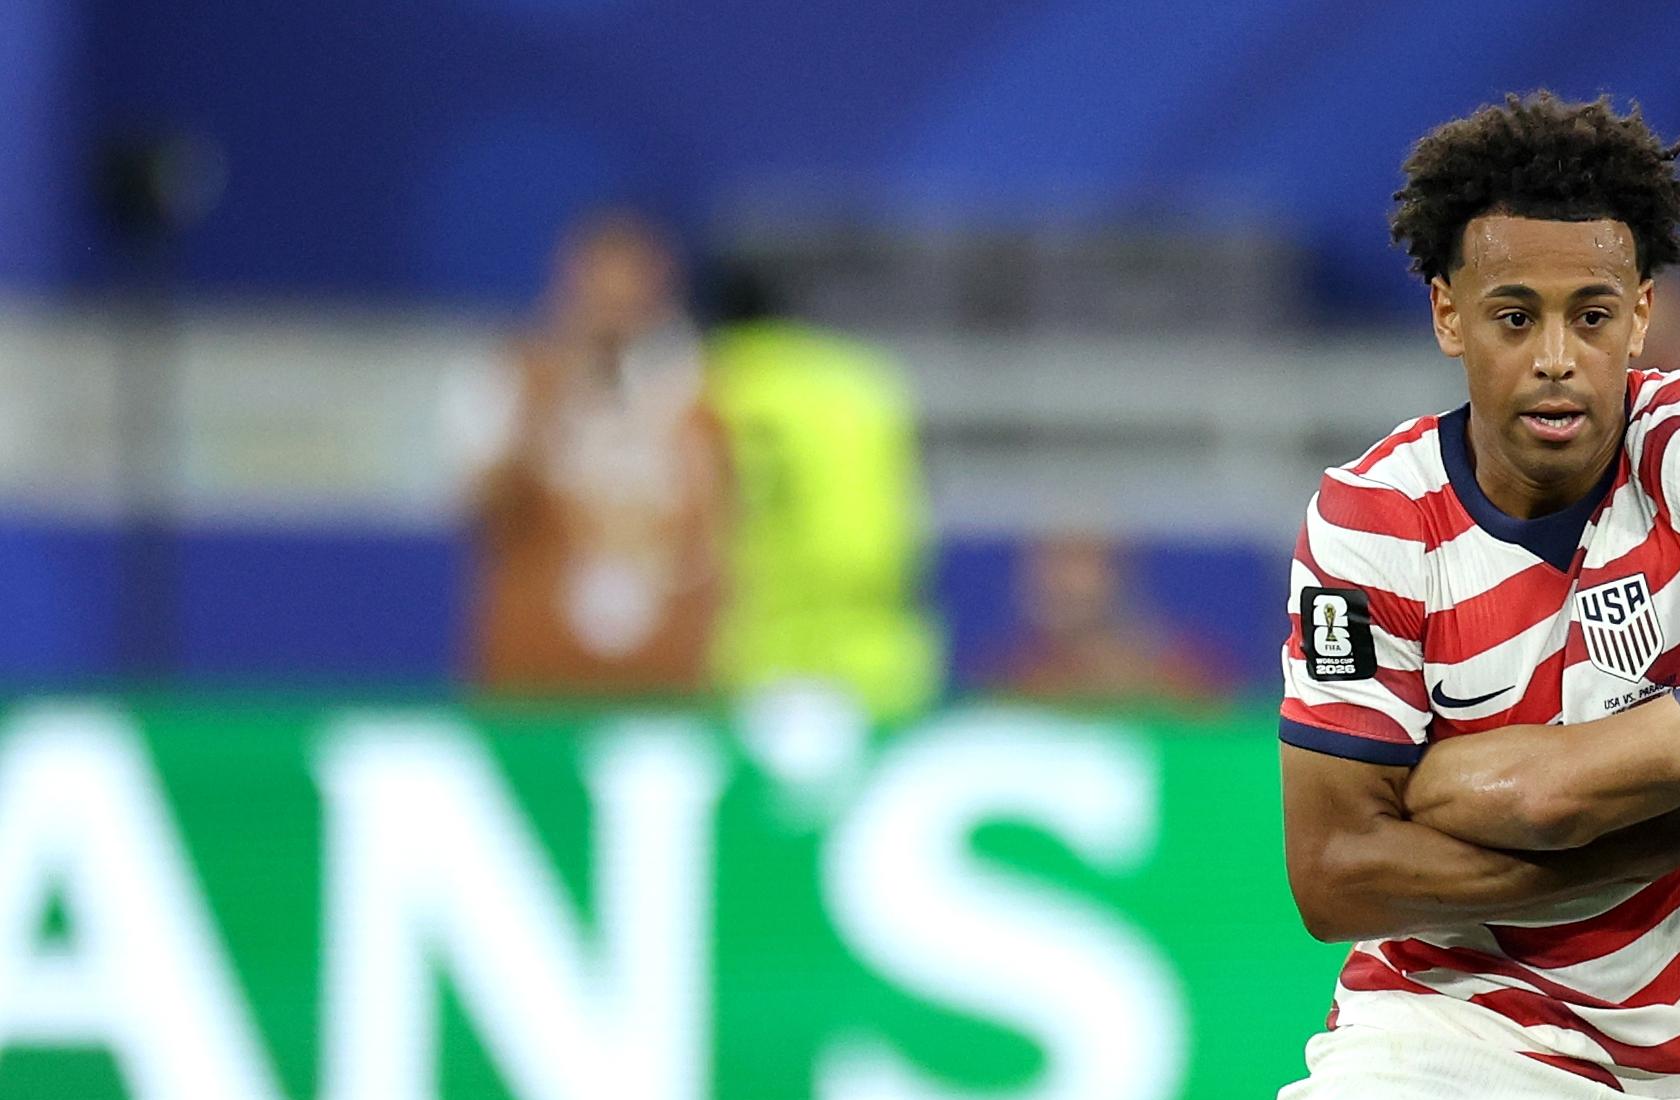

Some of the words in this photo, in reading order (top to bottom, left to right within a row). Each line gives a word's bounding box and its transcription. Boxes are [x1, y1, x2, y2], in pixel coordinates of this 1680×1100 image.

[1581, 580, 1645, 625] USA
[1316, 665, 1356, 674] 2026
[1604, 698, 1620, 710] USA
[1622, 692, 1636, 704] VS.
